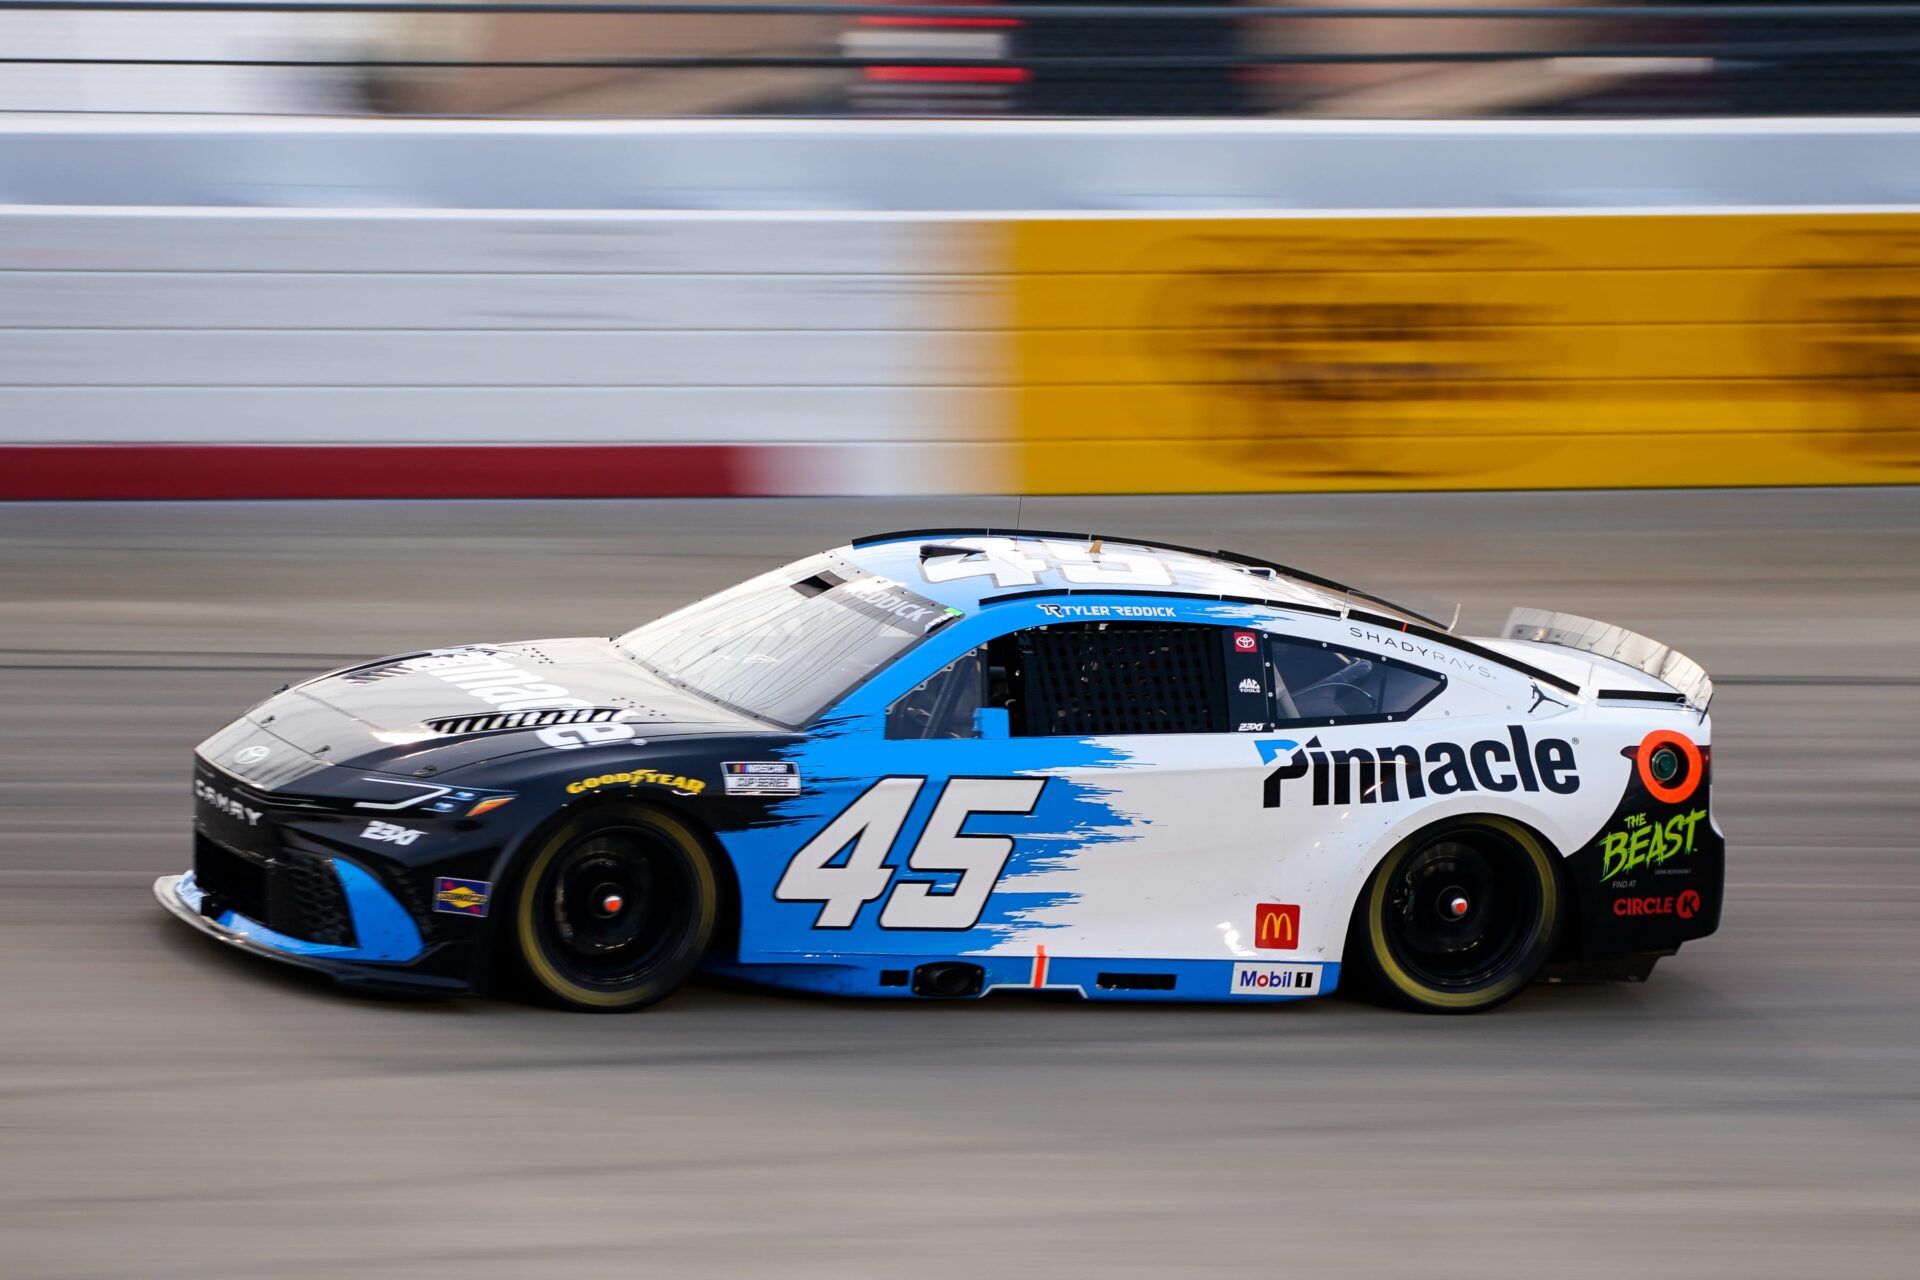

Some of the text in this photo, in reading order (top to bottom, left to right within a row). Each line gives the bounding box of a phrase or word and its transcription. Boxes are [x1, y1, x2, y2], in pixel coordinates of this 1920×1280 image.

[919, 537, 1176, 588] 45
[1062, 605, 1110, 616] TYLER
[1110, 606, 1177, 617] REDDICK
[1238, 678, 1261, 689] MAC
[749, 764, 788, 773] NASCAR
[1253, 724, 1580, 808] Pinnacle
[565, 769, 706, 794] GOODYEAR
[737, 778, 790, 788] CUP SERIES
[194, 779, 264, 826] CAMRY
[1623, 812, 1647, 828] THE
[773, 774, 1050, 931] 45
[1597, 808, 1706, 883] BEAST
[1612, 880, 1637, 889] FIND AT
[1613, 892, 1699, 918] CIRCLE K
[1240, 970, 1292, 988] Mobil
